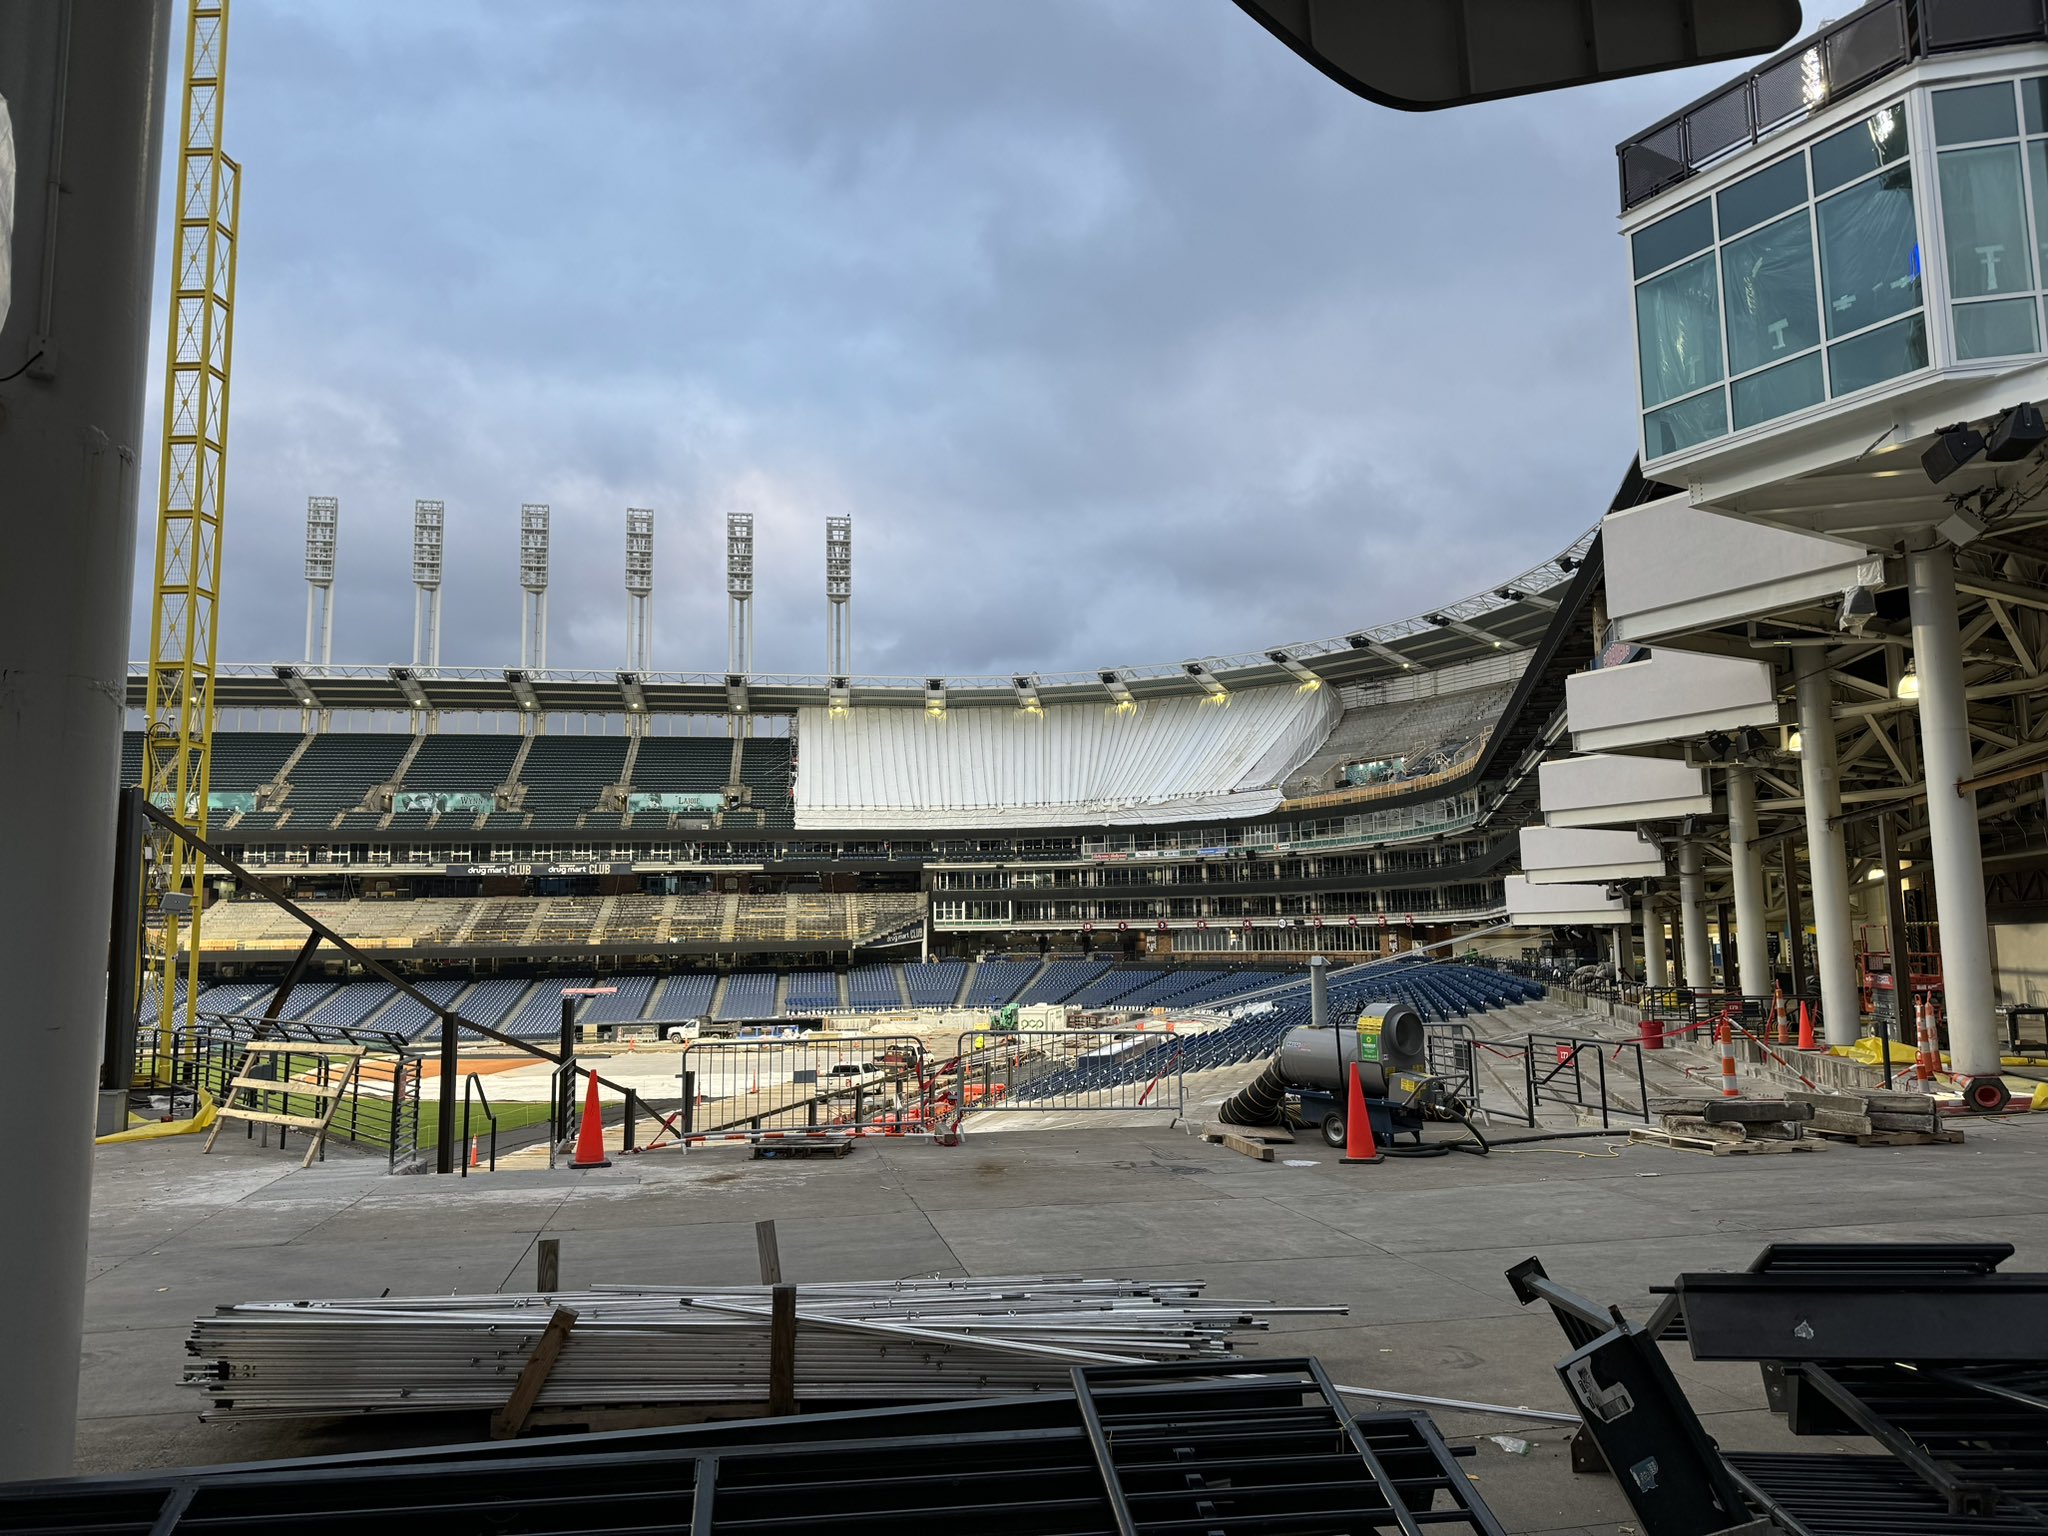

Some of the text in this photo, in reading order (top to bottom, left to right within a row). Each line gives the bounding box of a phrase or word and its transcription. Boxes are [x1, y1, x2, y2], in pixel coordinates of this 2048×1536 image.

[468, 864, 531, 876] drug mart CLUB
[548, 865, 567, 875] drug
[589, 864, 610, 875] CLUB
